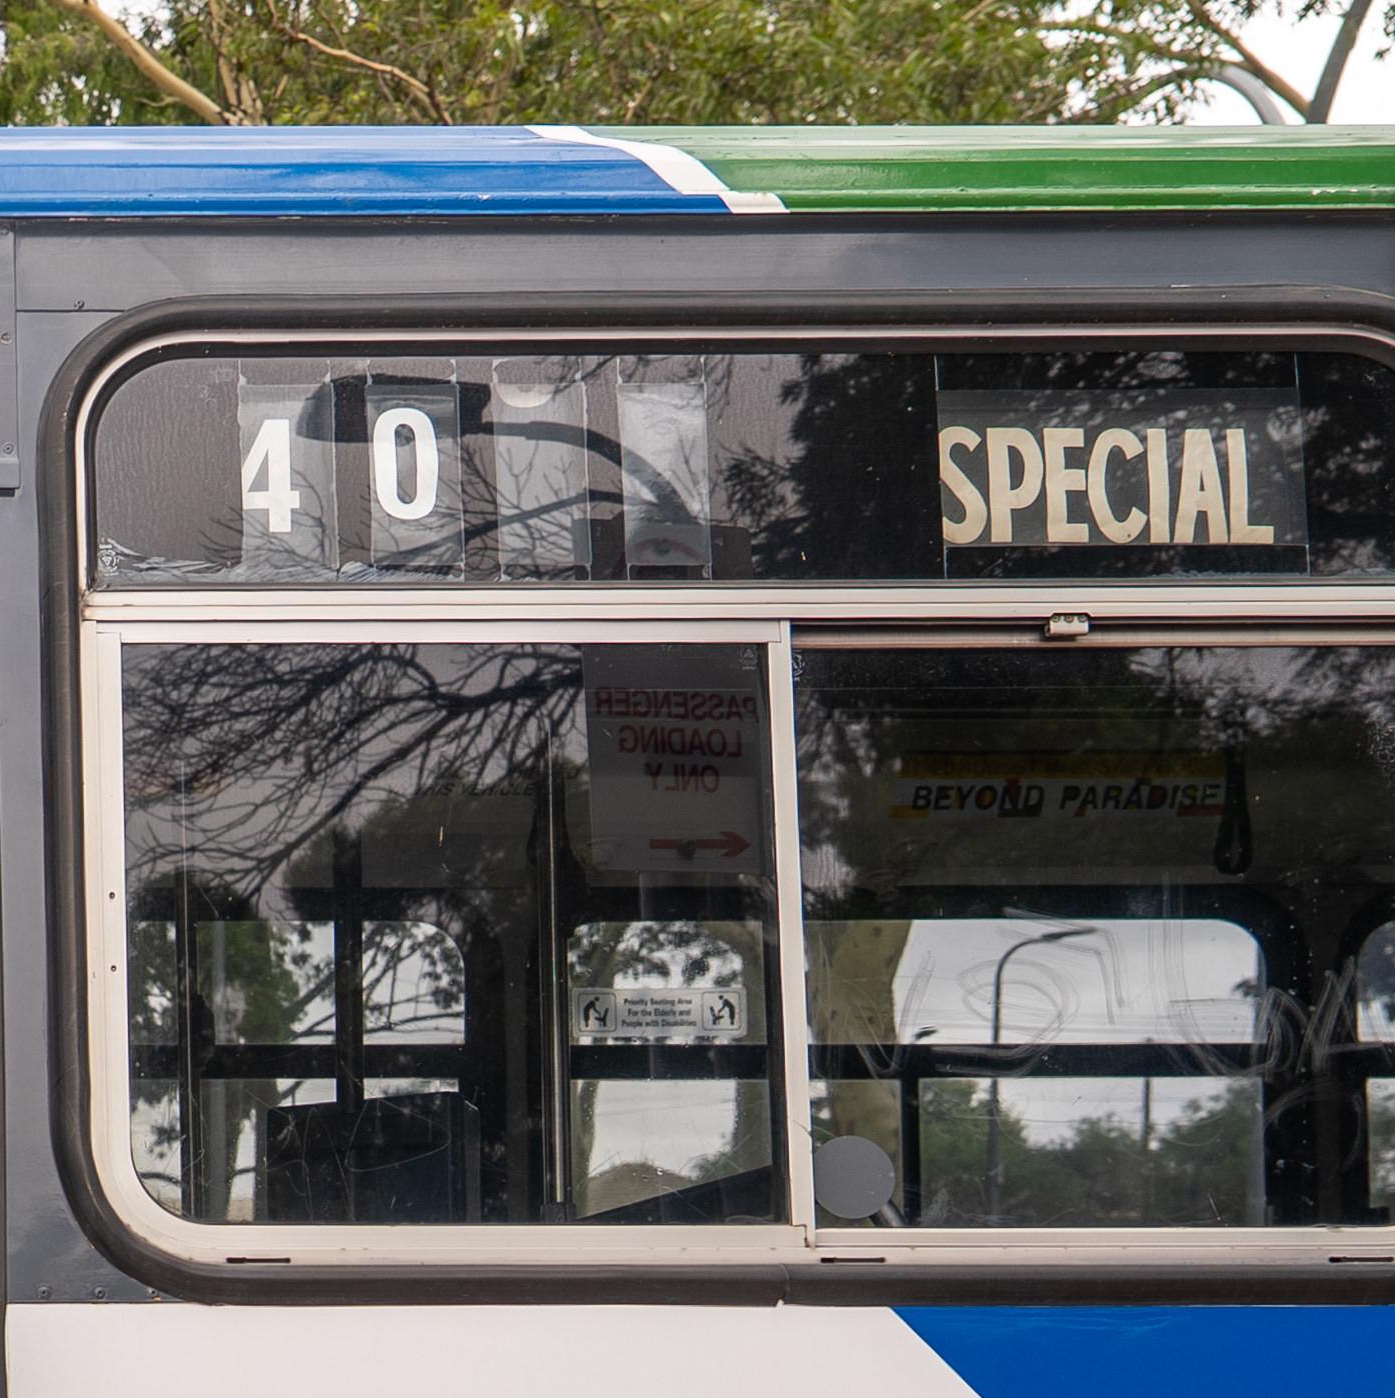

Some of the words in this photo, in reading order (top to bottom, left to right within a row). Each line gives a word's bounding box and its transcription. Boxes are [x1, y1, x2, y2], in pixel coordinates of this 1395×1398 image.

[938, 426, 1275, 545] SPECIAL
[911, 784, 1046, 811] BEYOND
[1059, 783, 1222, 811] PARADISE
